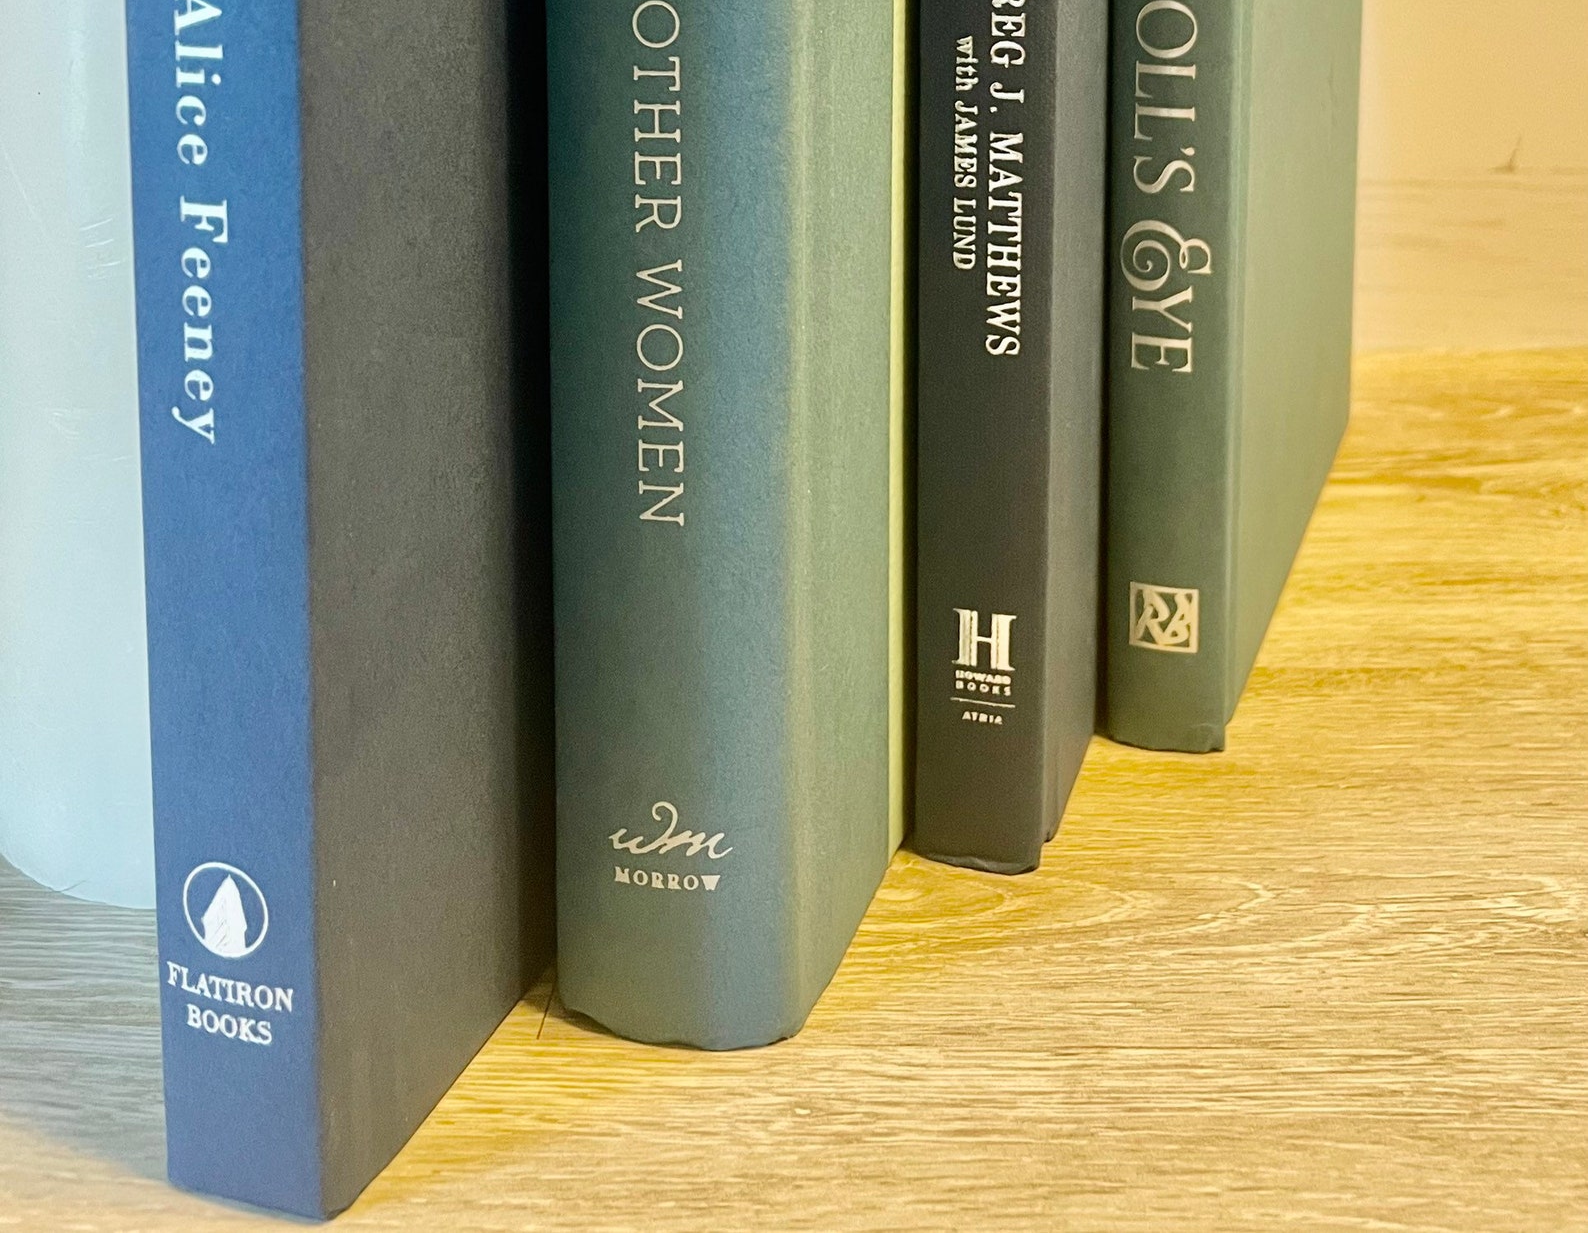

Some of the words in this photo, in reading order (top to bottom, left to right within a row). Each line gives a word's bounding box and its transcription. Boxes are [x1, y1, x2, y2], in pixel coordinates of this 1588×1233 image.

[954, 34, 980, 93] with
[630, 0, 684, 233] OTHER
[988, 80, 1026, 114] J.
[953, 100, 979, 189] JAMES
[952, 197, 978, 271] LUND
[985, 131, 1024, 357] MATTHEWS
[171, 195, 229, 444] Feeney
[1118, 218, 1213, 374] EYE
[635, 258, 686, 527] WOMEN
[954, 669, 1012, 686] HOWARD
[954, 679, 1012, 698] BOOKS
[961, 710, 1003, 725] ATRIA
[613, 865, 722, 892] MORROW
[166, 961, 294, 1012] FLATIRON
[186, 1004, 273, 1047] BOOKS
